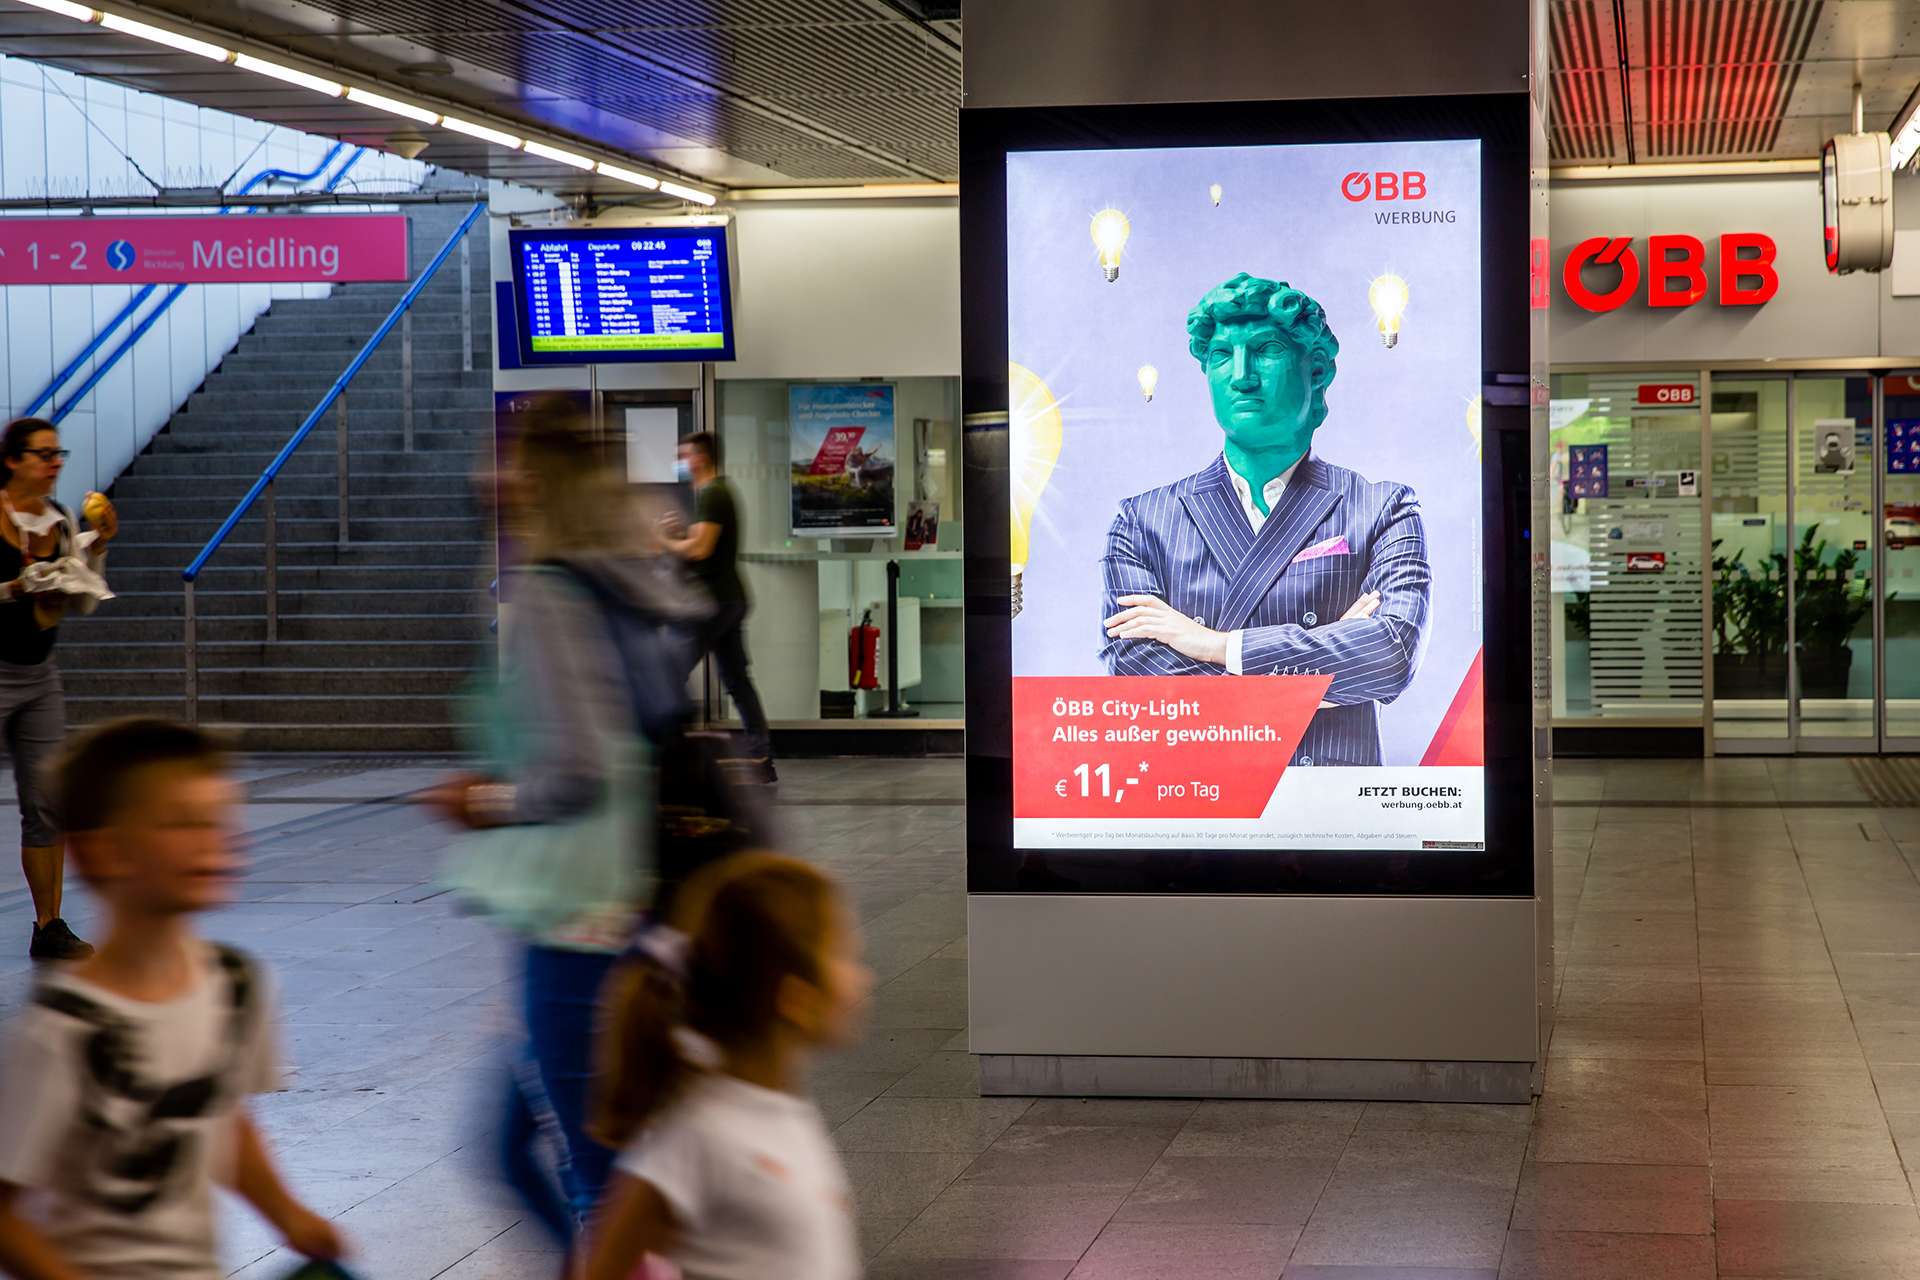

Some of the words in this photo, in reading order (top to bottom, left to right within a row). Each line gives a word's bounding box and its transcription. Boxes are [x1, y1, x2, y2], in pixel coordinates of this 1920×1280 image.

[1342, 171, 1426, 202] ÖBB
[1375, 211, 1456, 224] WERBUNG
[193, 238, 339, 276] Meidling
[1563, 232, 1779, 312] ÖBB
[1656, 388, 1692, 402] ÖBB
[1052, 697, 1094, 716] ÖBB
[1102, 699, 1200, 720] City-Light
[1052, 726, 1098, 742] Alles
[1104, 725, 1160, 742] außer
[1166, 725, 1282, 746] gewöhnlich.
[1055, 779, 1067, 797] €
[1158, 784, 1185, 800] pro
[1190, 781, 1220, 801] Tag
[1358, 787, 1397, 797] JETZT
[1402, 786, 1462, 797] BUCHEN:
[1381, 800, 1462, 810] werbung.oebb.at
[1356, 832, 1382, 841] Abgaben
